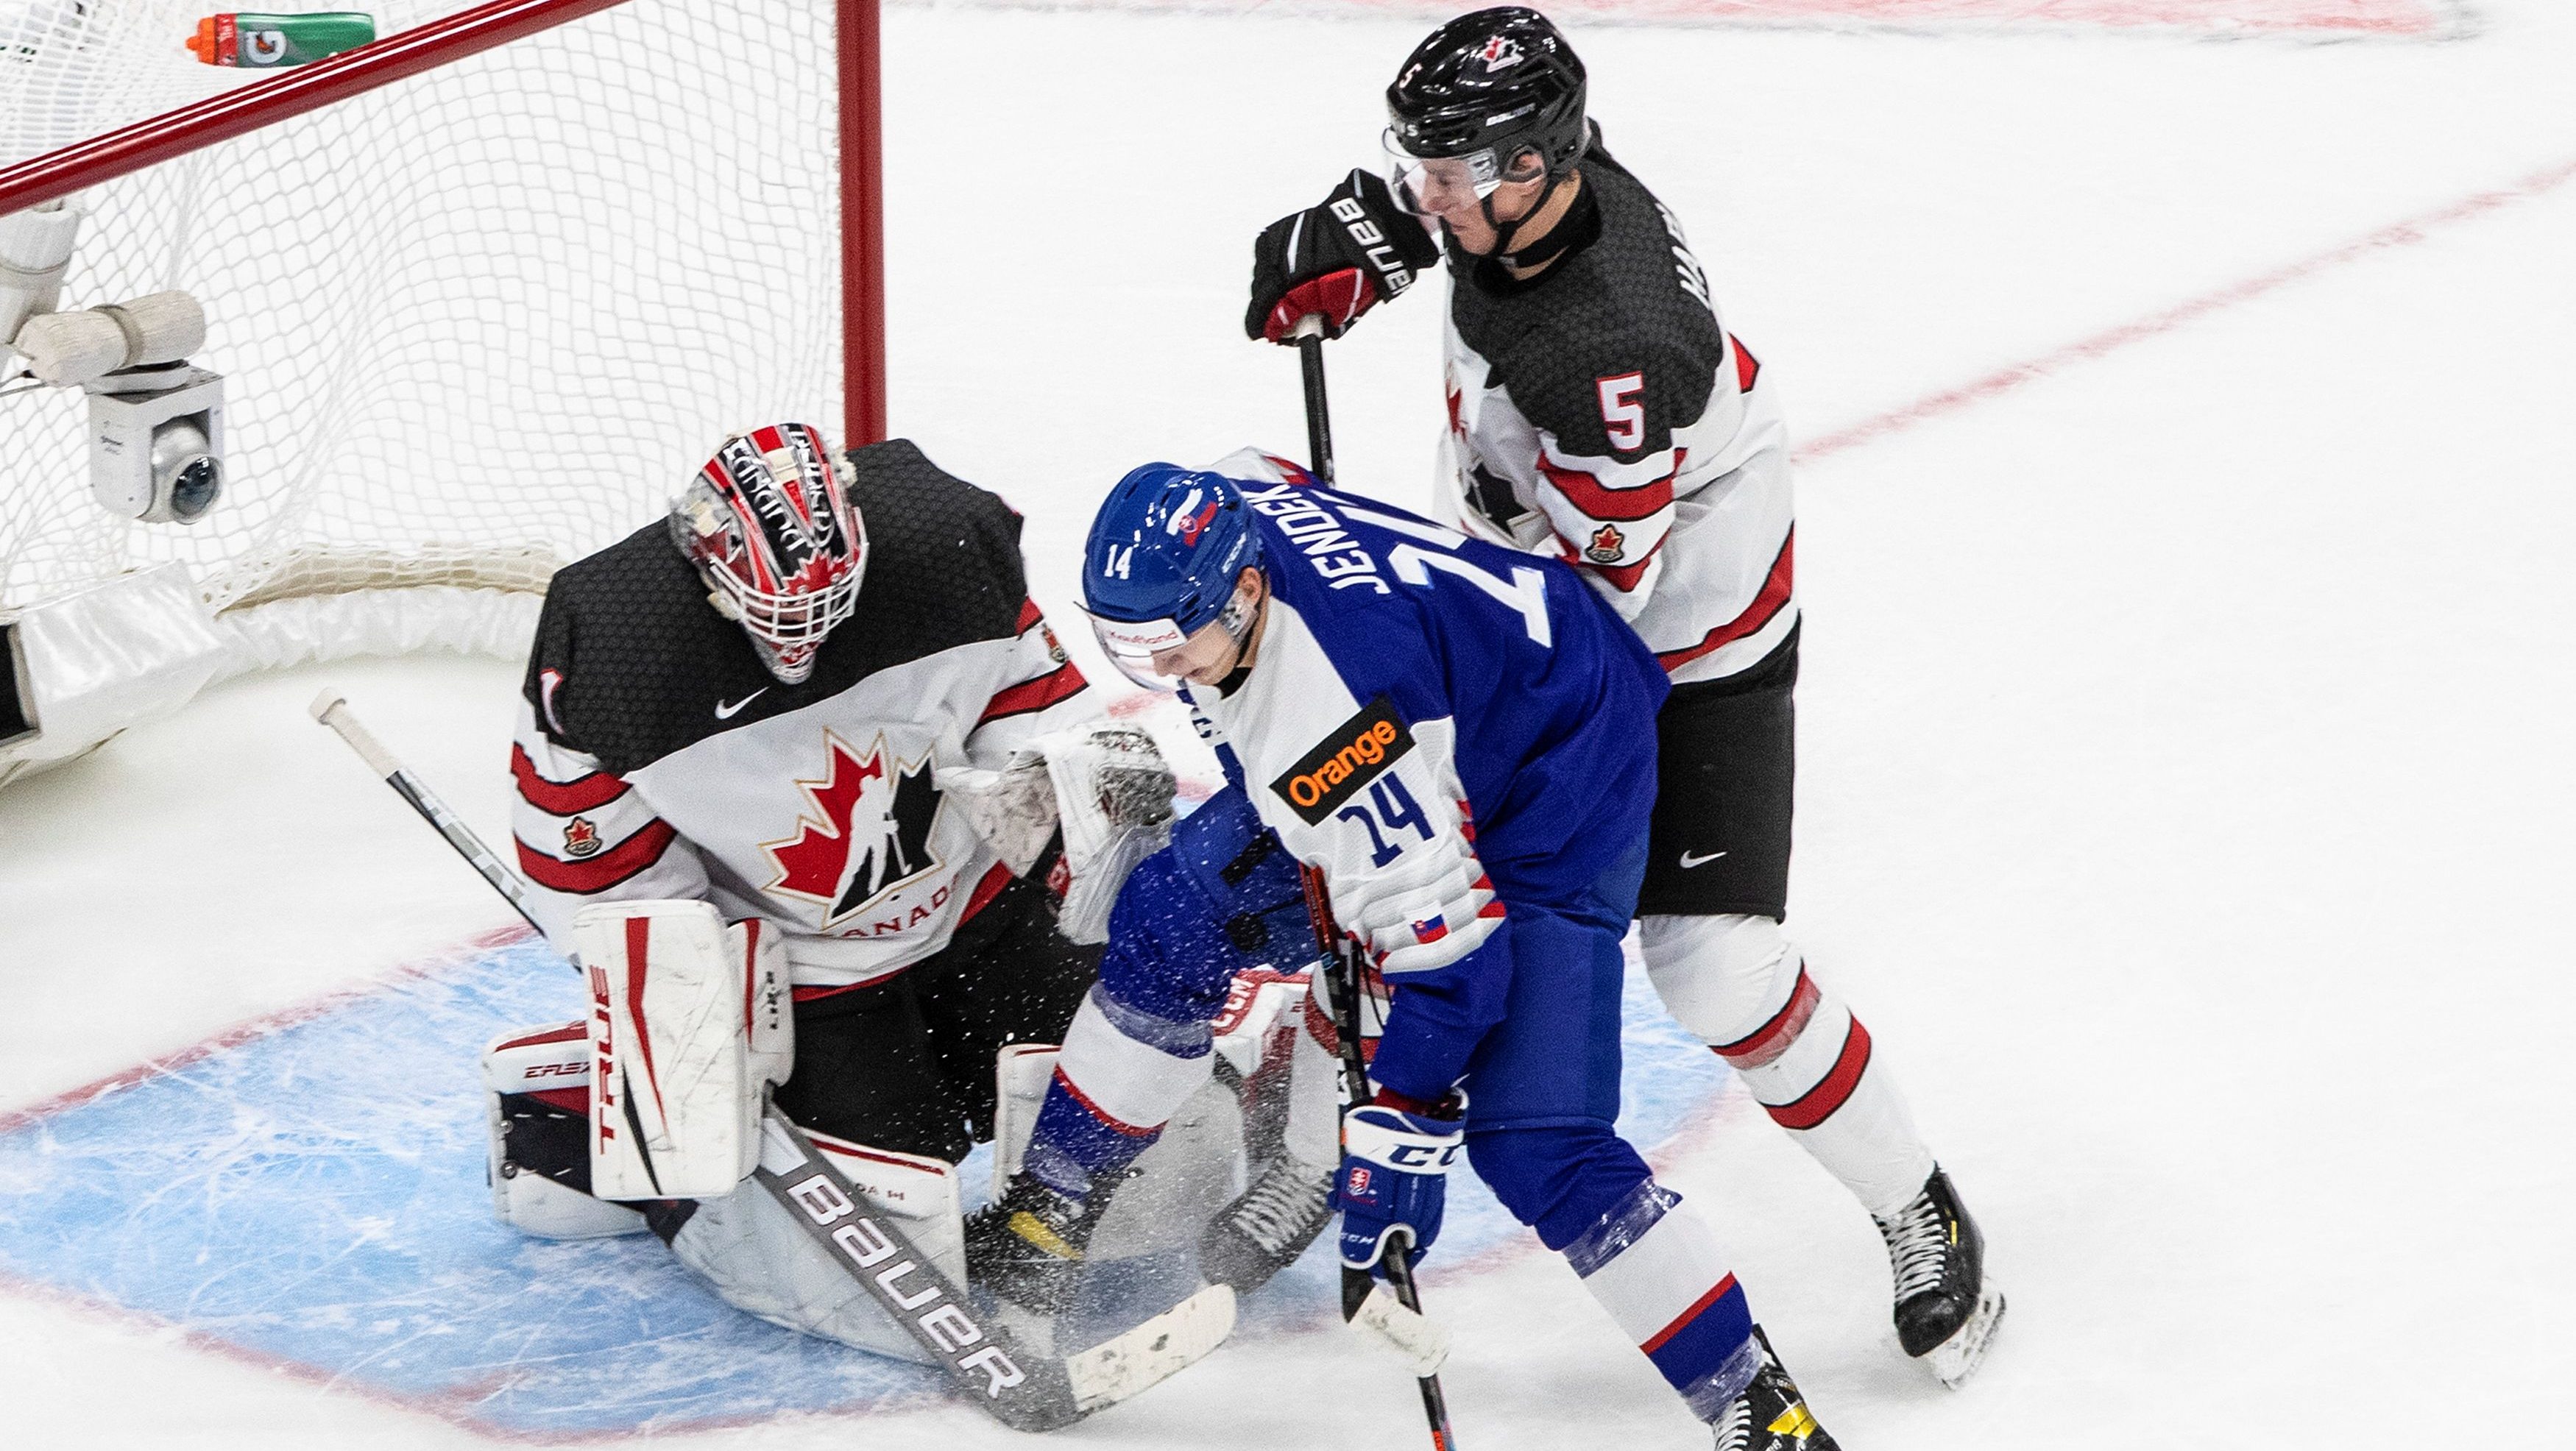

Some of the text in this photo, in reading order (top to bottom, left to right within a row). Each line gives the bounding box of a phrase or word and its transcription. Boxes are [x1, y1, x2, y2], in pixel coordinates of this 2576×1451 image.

[1328, 196, 1415, 297] BAUE
[1596, 371, 1646, 453] 5
[1104, 543, 1134, 581] 14
[1245, 483, 1393, 595] JENDEK
[540, 667, 564, 735] 1
[1288, 719, 1398, 808] Orange
[1335, 770, 1436, 869] 14
[841, 871, 960, 937] ANAD
[589, 965, 616, 1155] TRUE
[1388, 1143, 1460, 1167] CC
[785, 1173, 1027, 1399] BAUER
